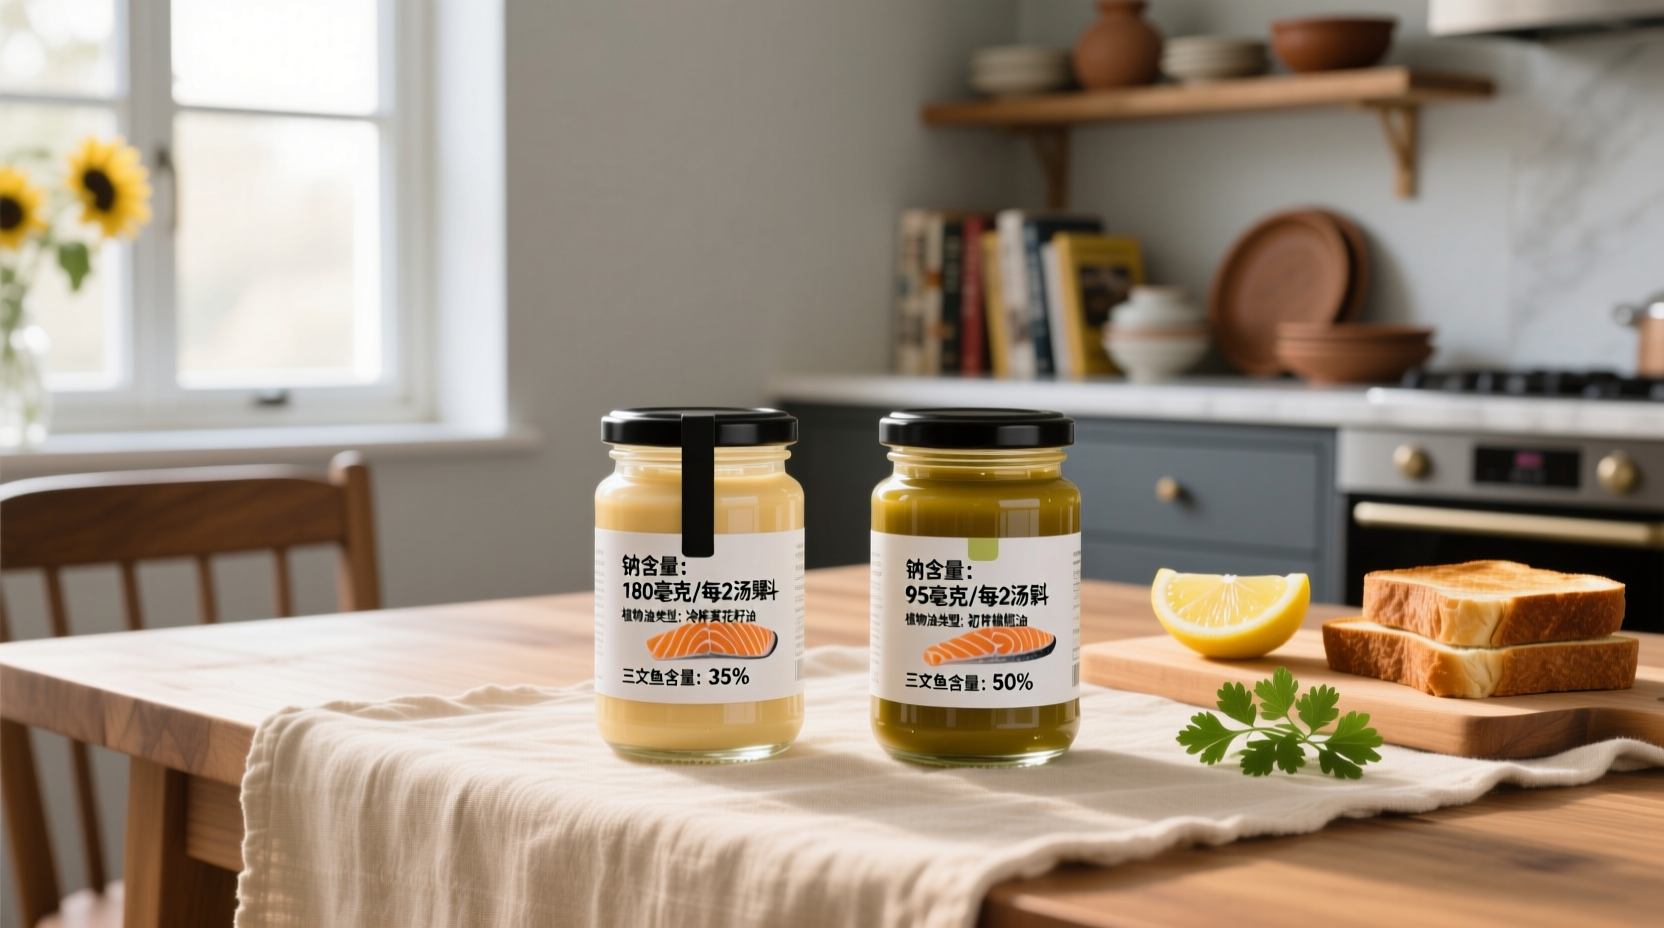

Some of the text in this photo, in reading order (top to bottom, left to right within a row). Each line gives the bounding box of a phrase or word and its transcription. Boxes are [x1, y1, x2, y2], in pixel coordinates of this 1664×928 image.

[622, 554, 687, 577] 钠含量：
[905, 558, 973, 580] 钠含量：
